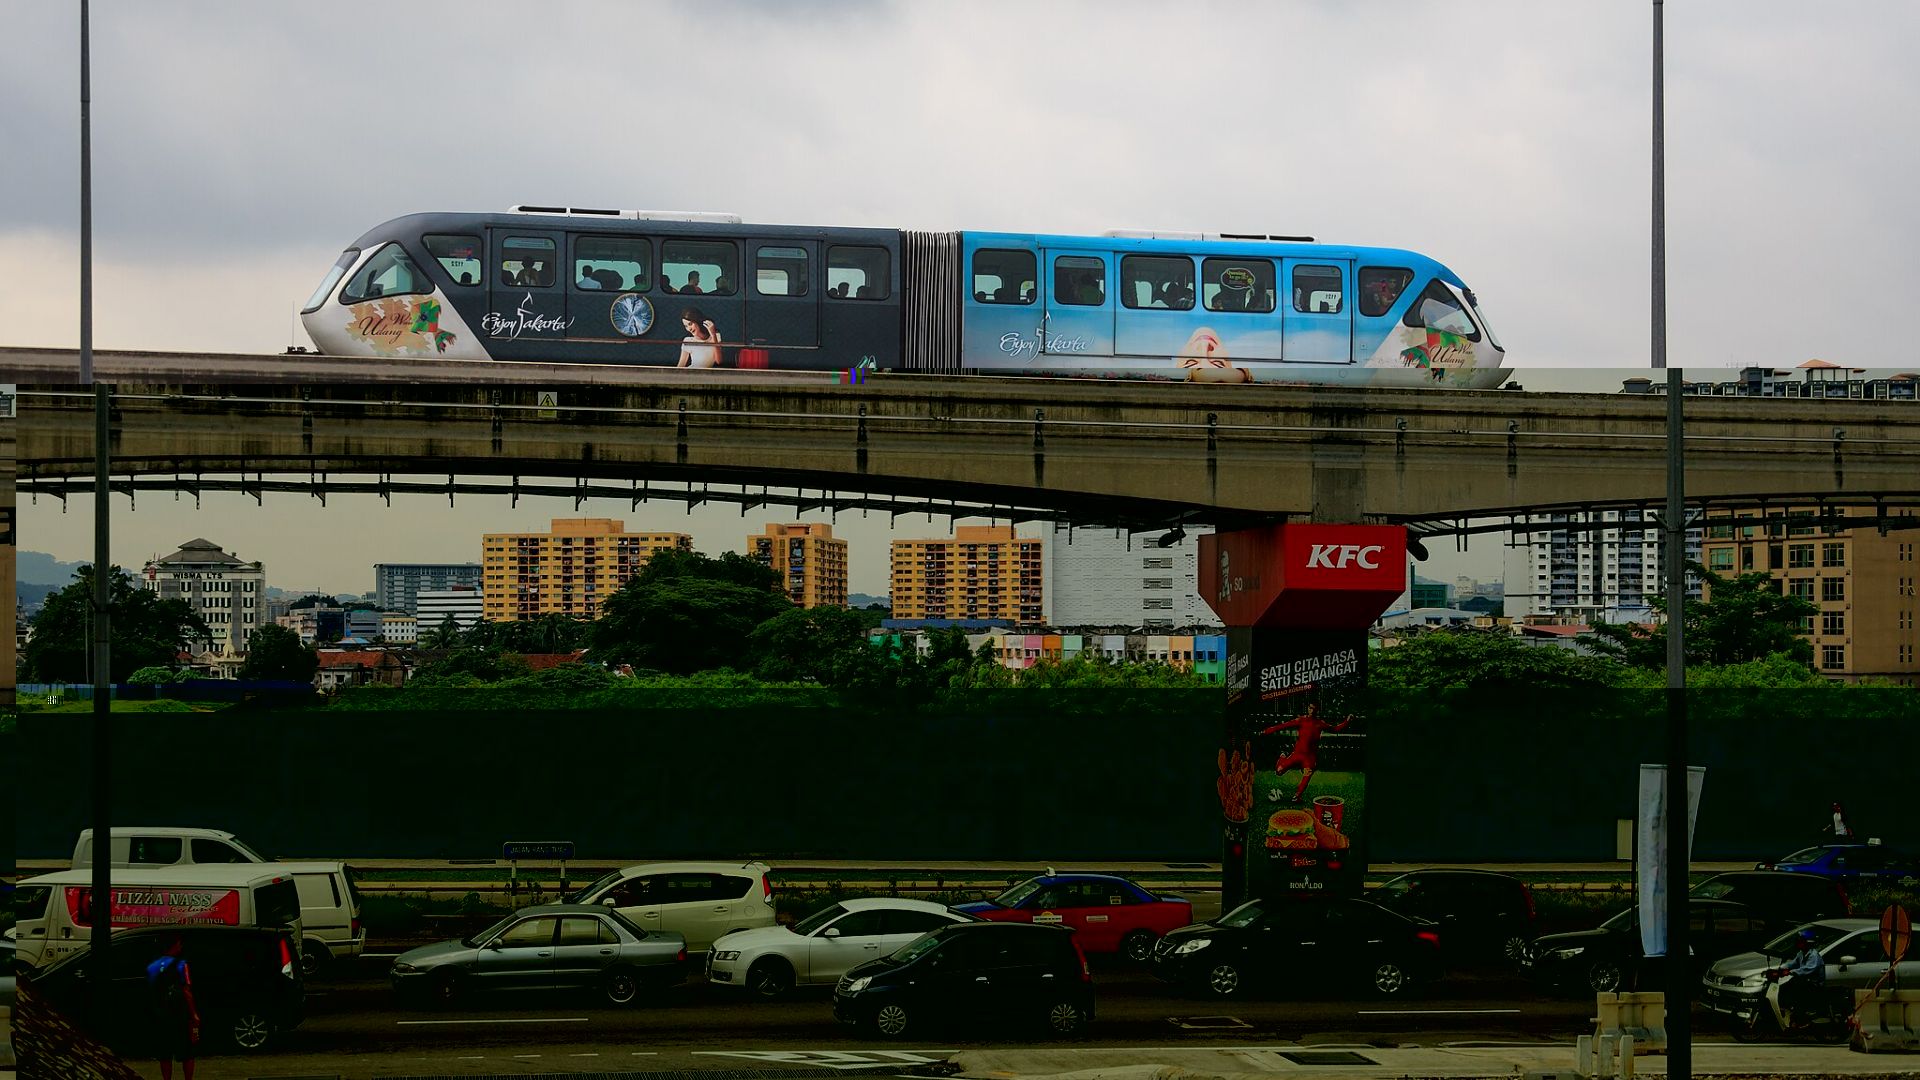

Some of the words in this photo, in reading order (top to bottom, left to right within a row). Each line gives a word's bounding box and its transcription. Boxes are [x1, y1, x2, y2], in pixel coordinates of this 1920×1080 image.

[359, 316, 403, 344] Udang
[482, 312, 517, 338] Enjoy
[999, 332, 1035, 356] Enjoy
[1430, 344, 1465, 368] Udang
[1306, 545, 1382, 569] KFC
[1261, 663, 1291, 681] SATU
[1295, 657, 1320, 674] CITA
[1324, 649, 1356, 667] RASA
[1261, 675, 1291, 693] SATU
[1294, 660, 1359, 685] SEMANGAT
[117, 892, 164, 905] LIZZA
[168, 893, 212, 906] NASS
